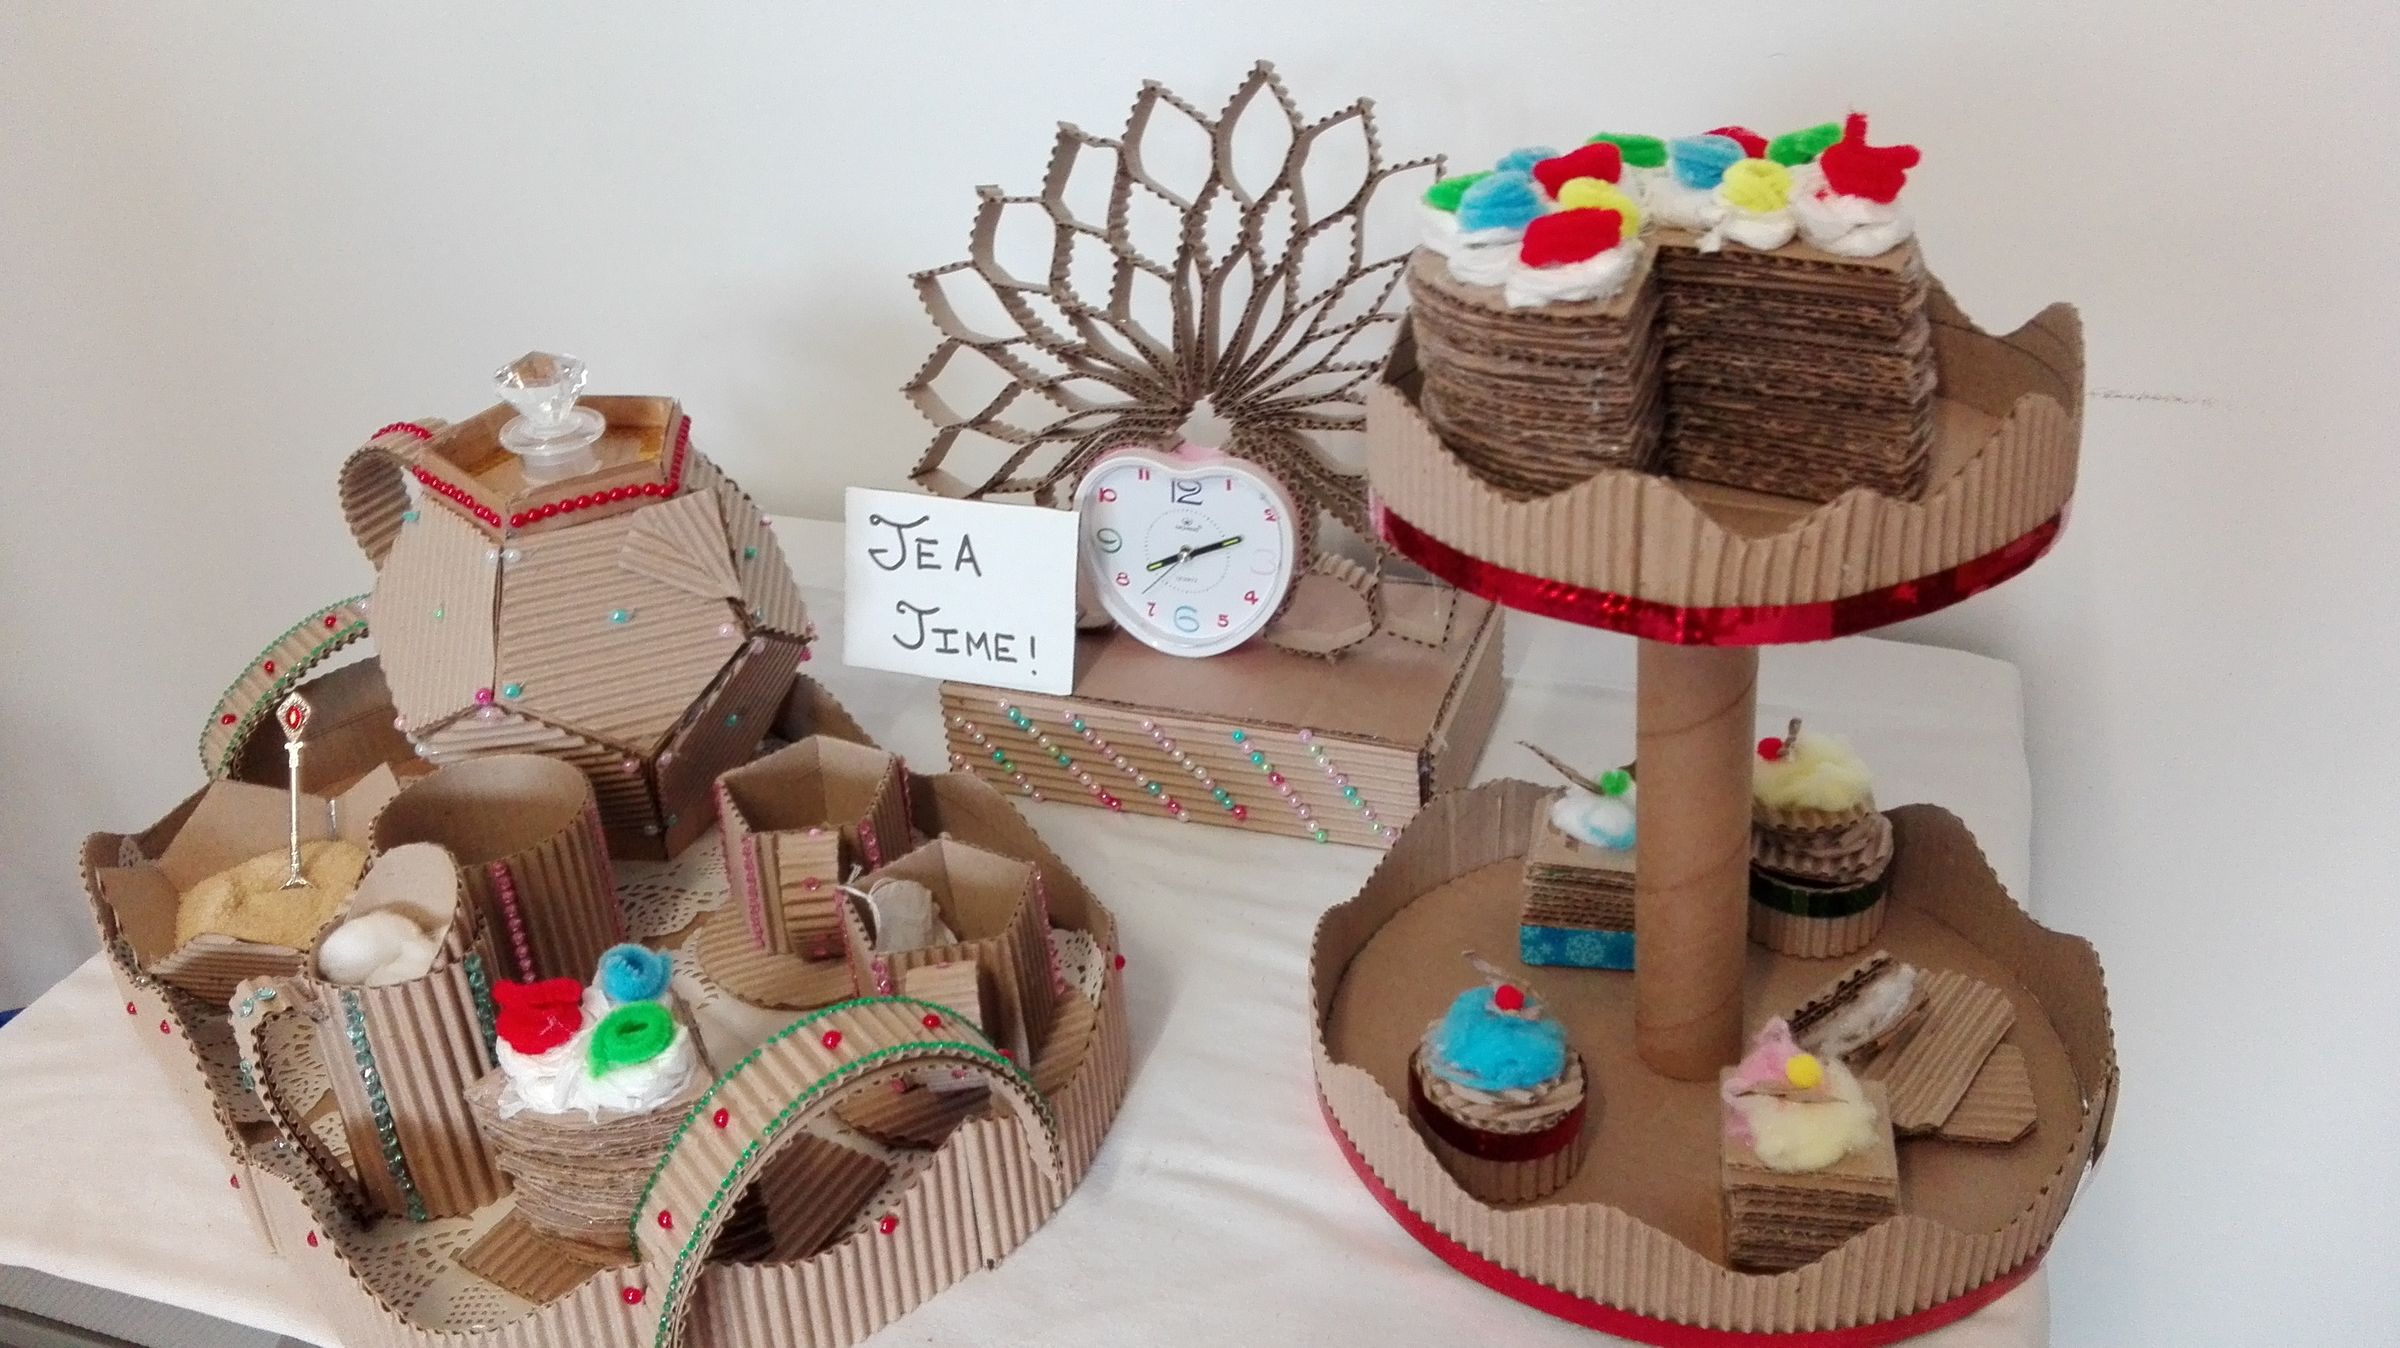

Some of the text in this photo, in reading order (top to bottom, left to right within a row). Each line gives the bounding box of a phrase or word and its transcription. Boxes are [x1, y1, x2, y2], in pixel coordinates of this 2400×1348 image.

[1138, 468, 1151, 481] 11
[1170, 478, 1204, 506] 12
[1226, 479, 1232, 491] 1
[1099, 487, 1118, 503] 10
[1263, 508, 1277, 522] 2
[1096, 527, 1123, 554] 9
[1115, 572, 1131, 587] 8
[1244, 590, 1259, 605] 4
[1147, 602, 1156, 617] 7
[1173, 605, 1200, 633] 6
[1217, 614, 1229, 628] 5
